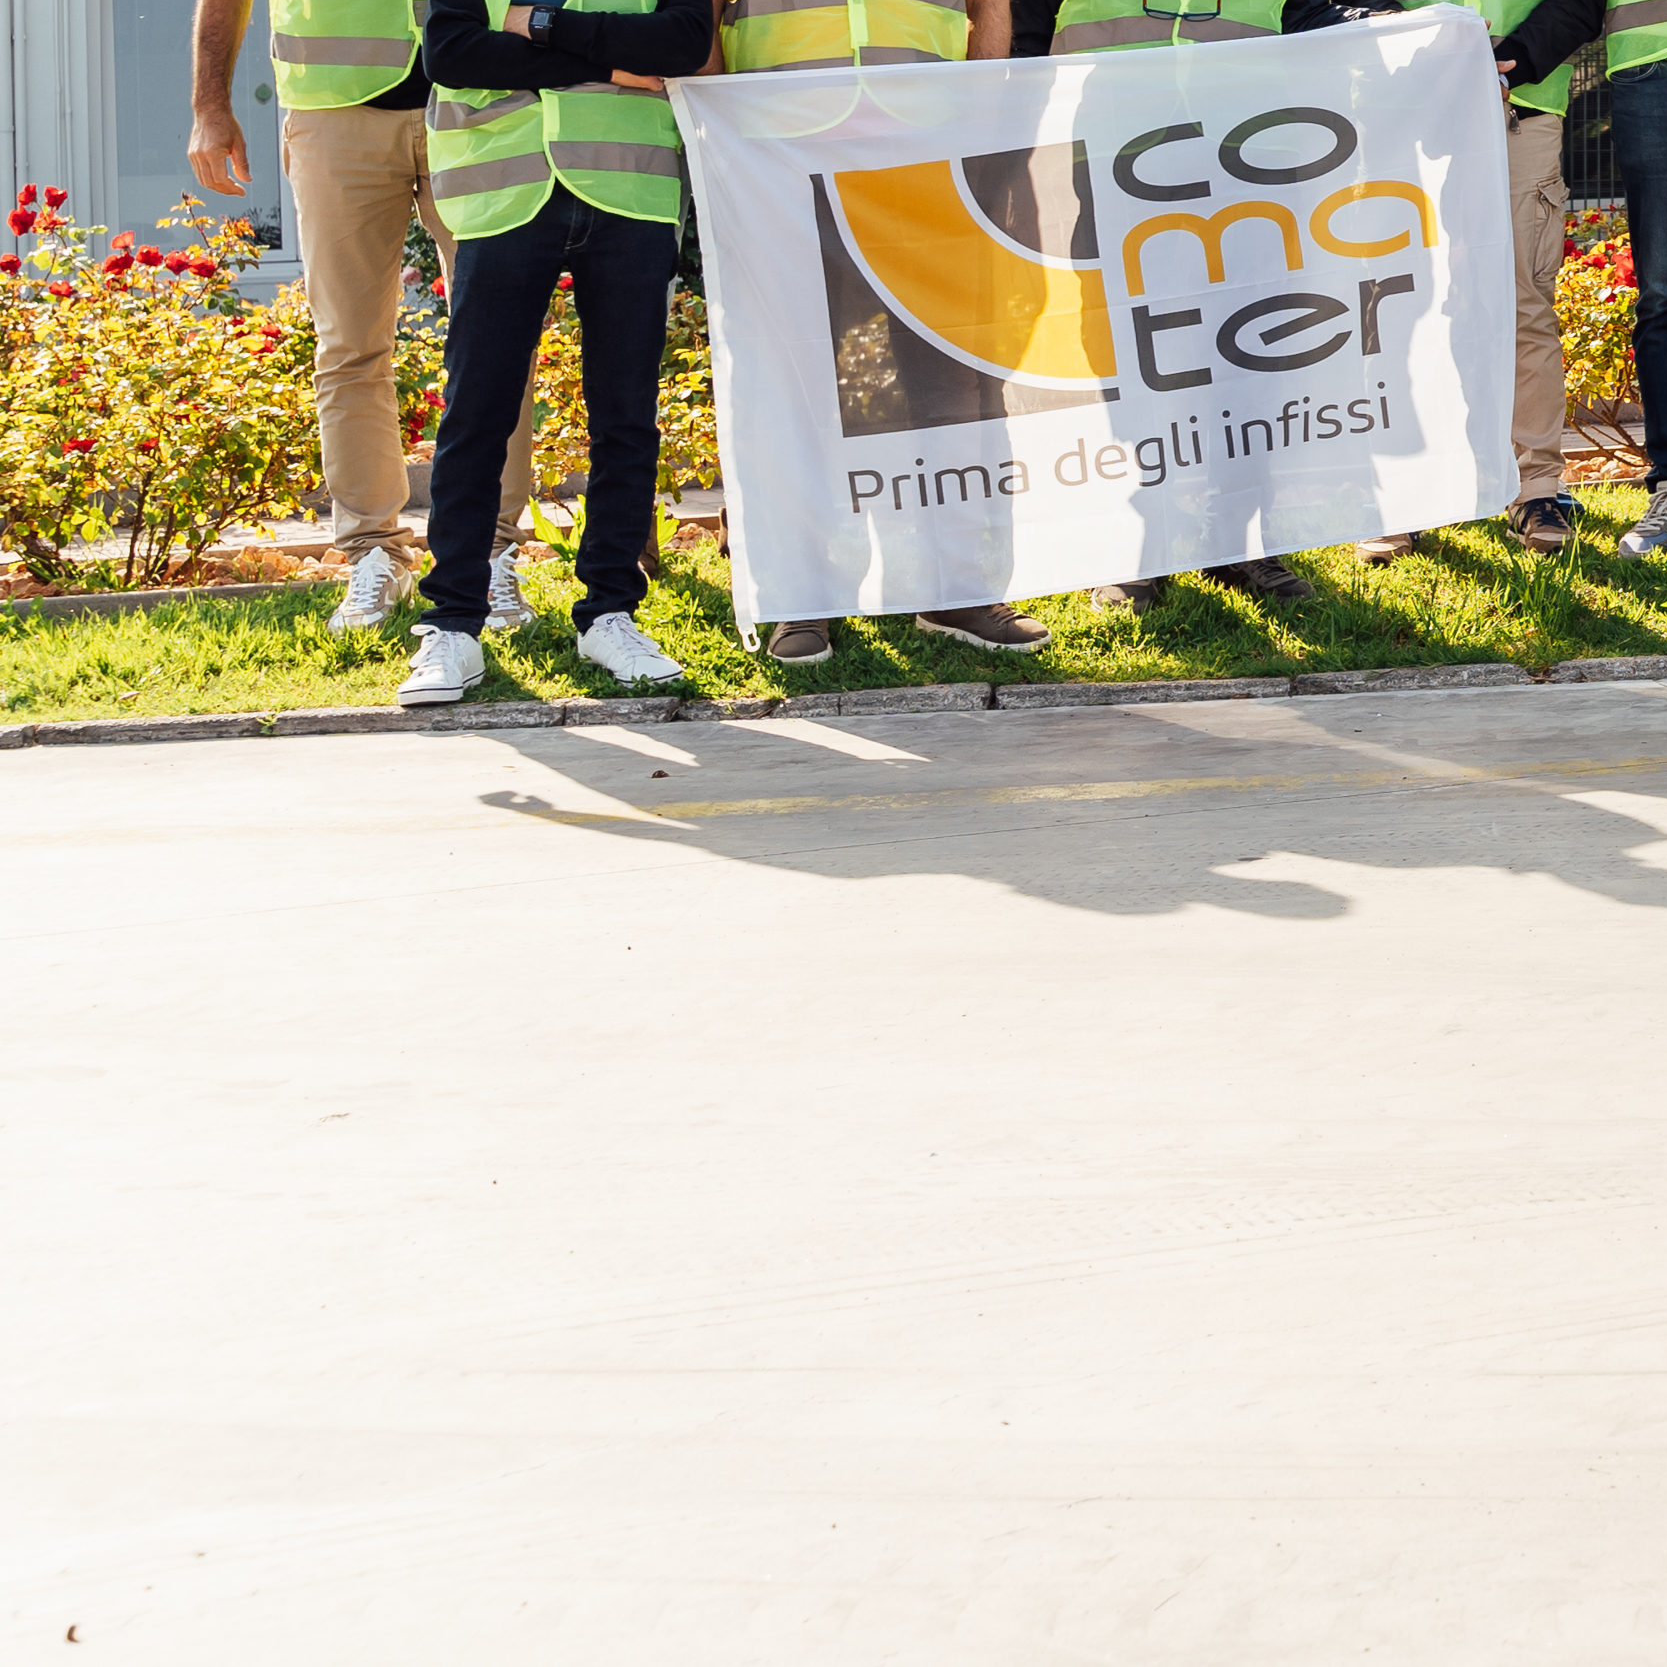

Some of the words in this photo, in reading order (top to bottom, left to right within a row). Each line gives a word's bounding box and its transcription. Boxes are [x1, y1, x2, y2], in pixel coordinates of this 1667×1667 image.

[847, 457, 1030, 514] Prima
[1053, 414, 1203, 488] degli
[1222, 380, 1392, 460] infissi
